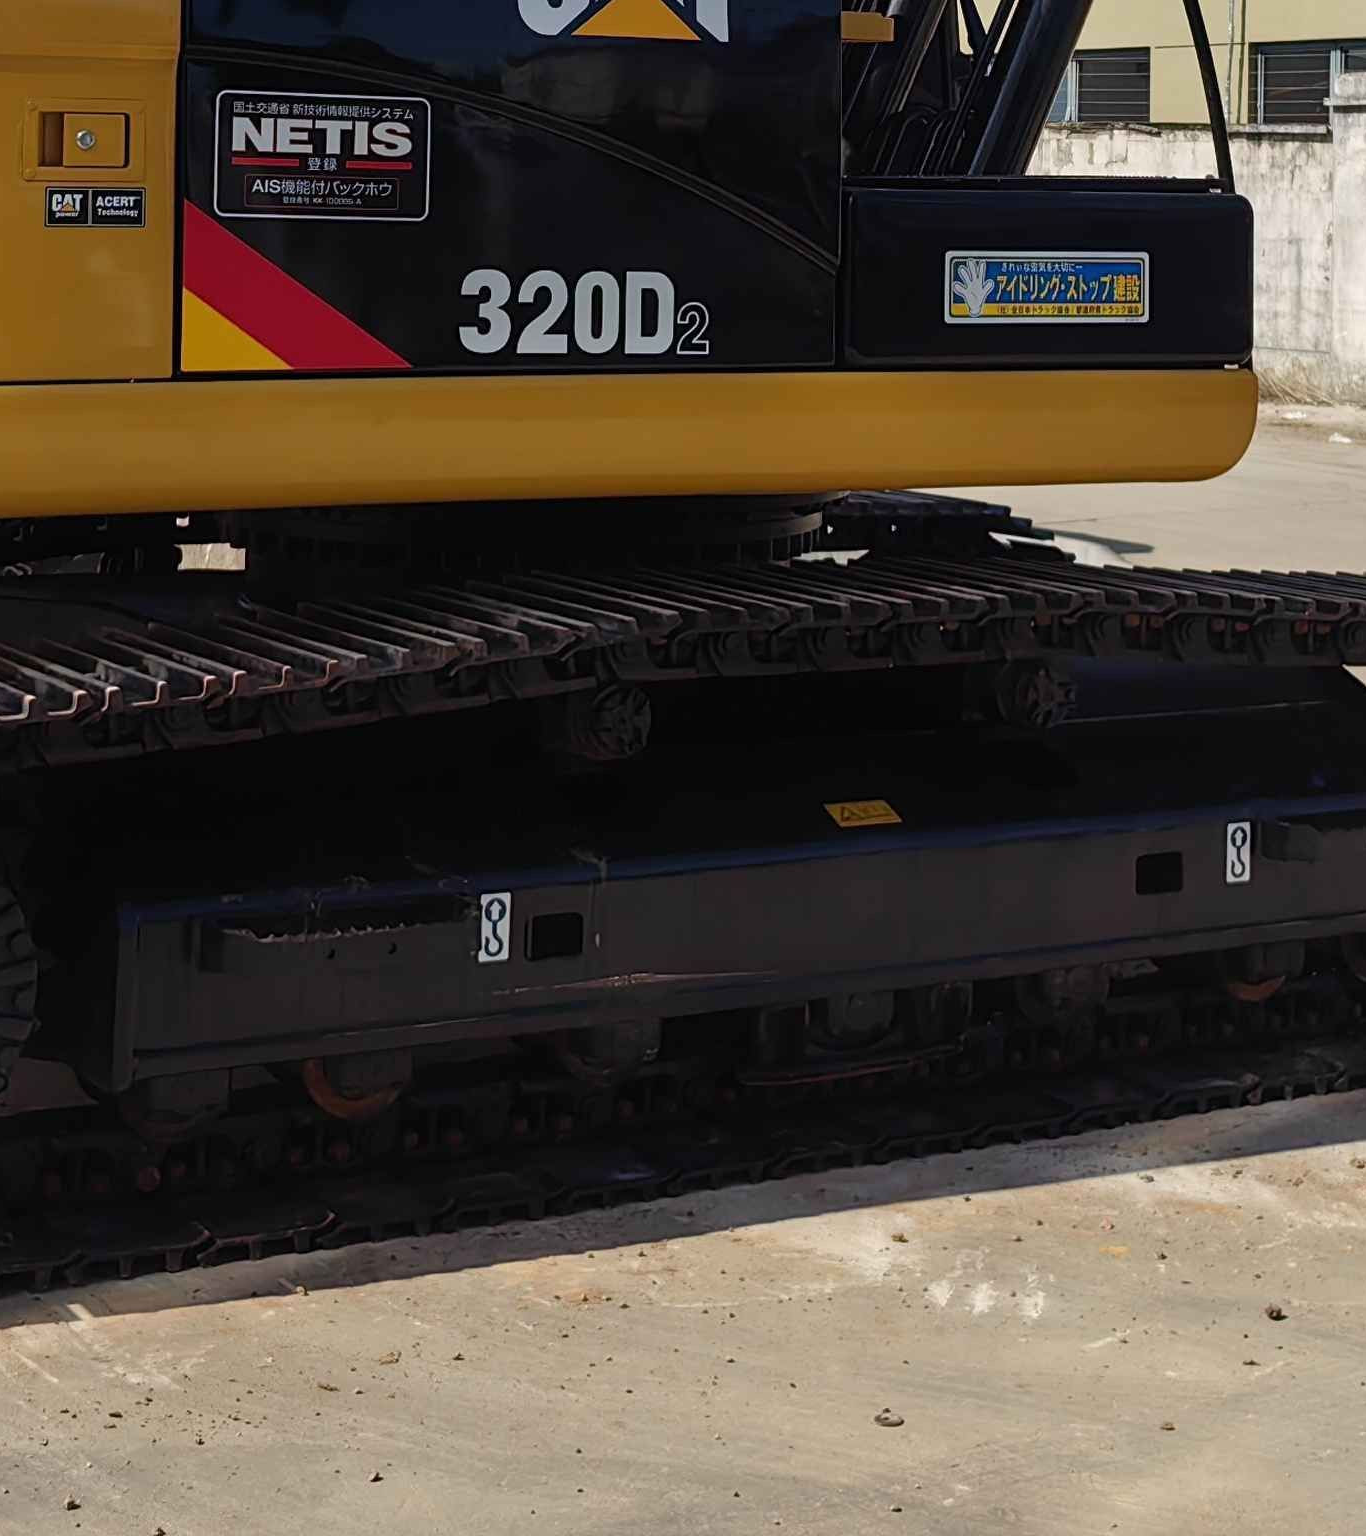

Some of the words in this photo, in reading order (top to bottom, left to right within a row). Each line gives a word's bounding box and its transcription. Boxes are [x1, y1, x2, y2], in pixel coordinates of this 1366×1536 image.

[233, 101, 289, 114] 国土交通省
[231, 116, 413, 158] NETIS
[307, 157, 338, 172] 登録
[251, 178, 393, 197] AIS機能付バックホウ
[51, 193, 84, 212] CAT
[95, 195, 136, 208] ACERT
[97, 207, 139, 218] Technology
